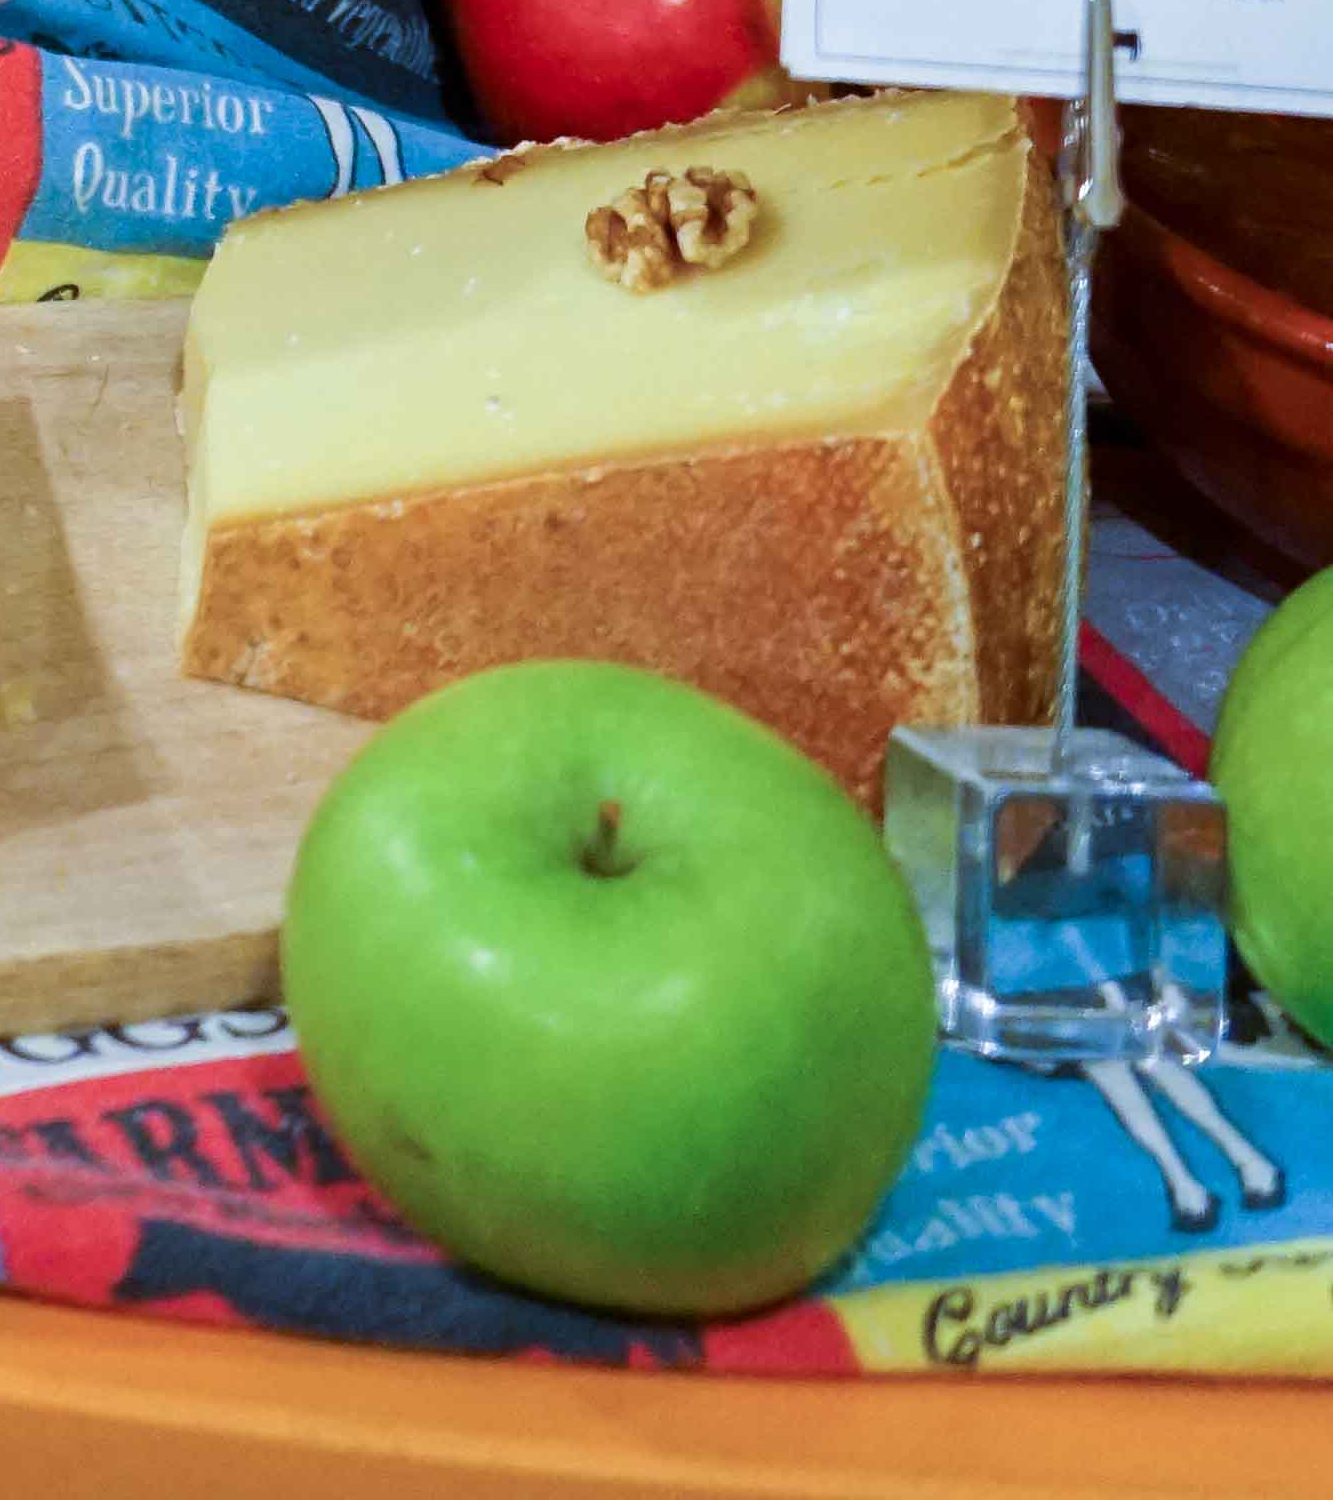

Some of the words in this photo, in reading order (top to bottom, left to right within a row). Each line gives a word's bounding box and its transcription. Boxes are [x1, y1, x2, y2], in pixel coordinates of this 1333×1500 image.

[62, 54, 274, 141] Superior
[73, 141, 259, 222] Quality
[922, 1264, 1190, 1371] Country
